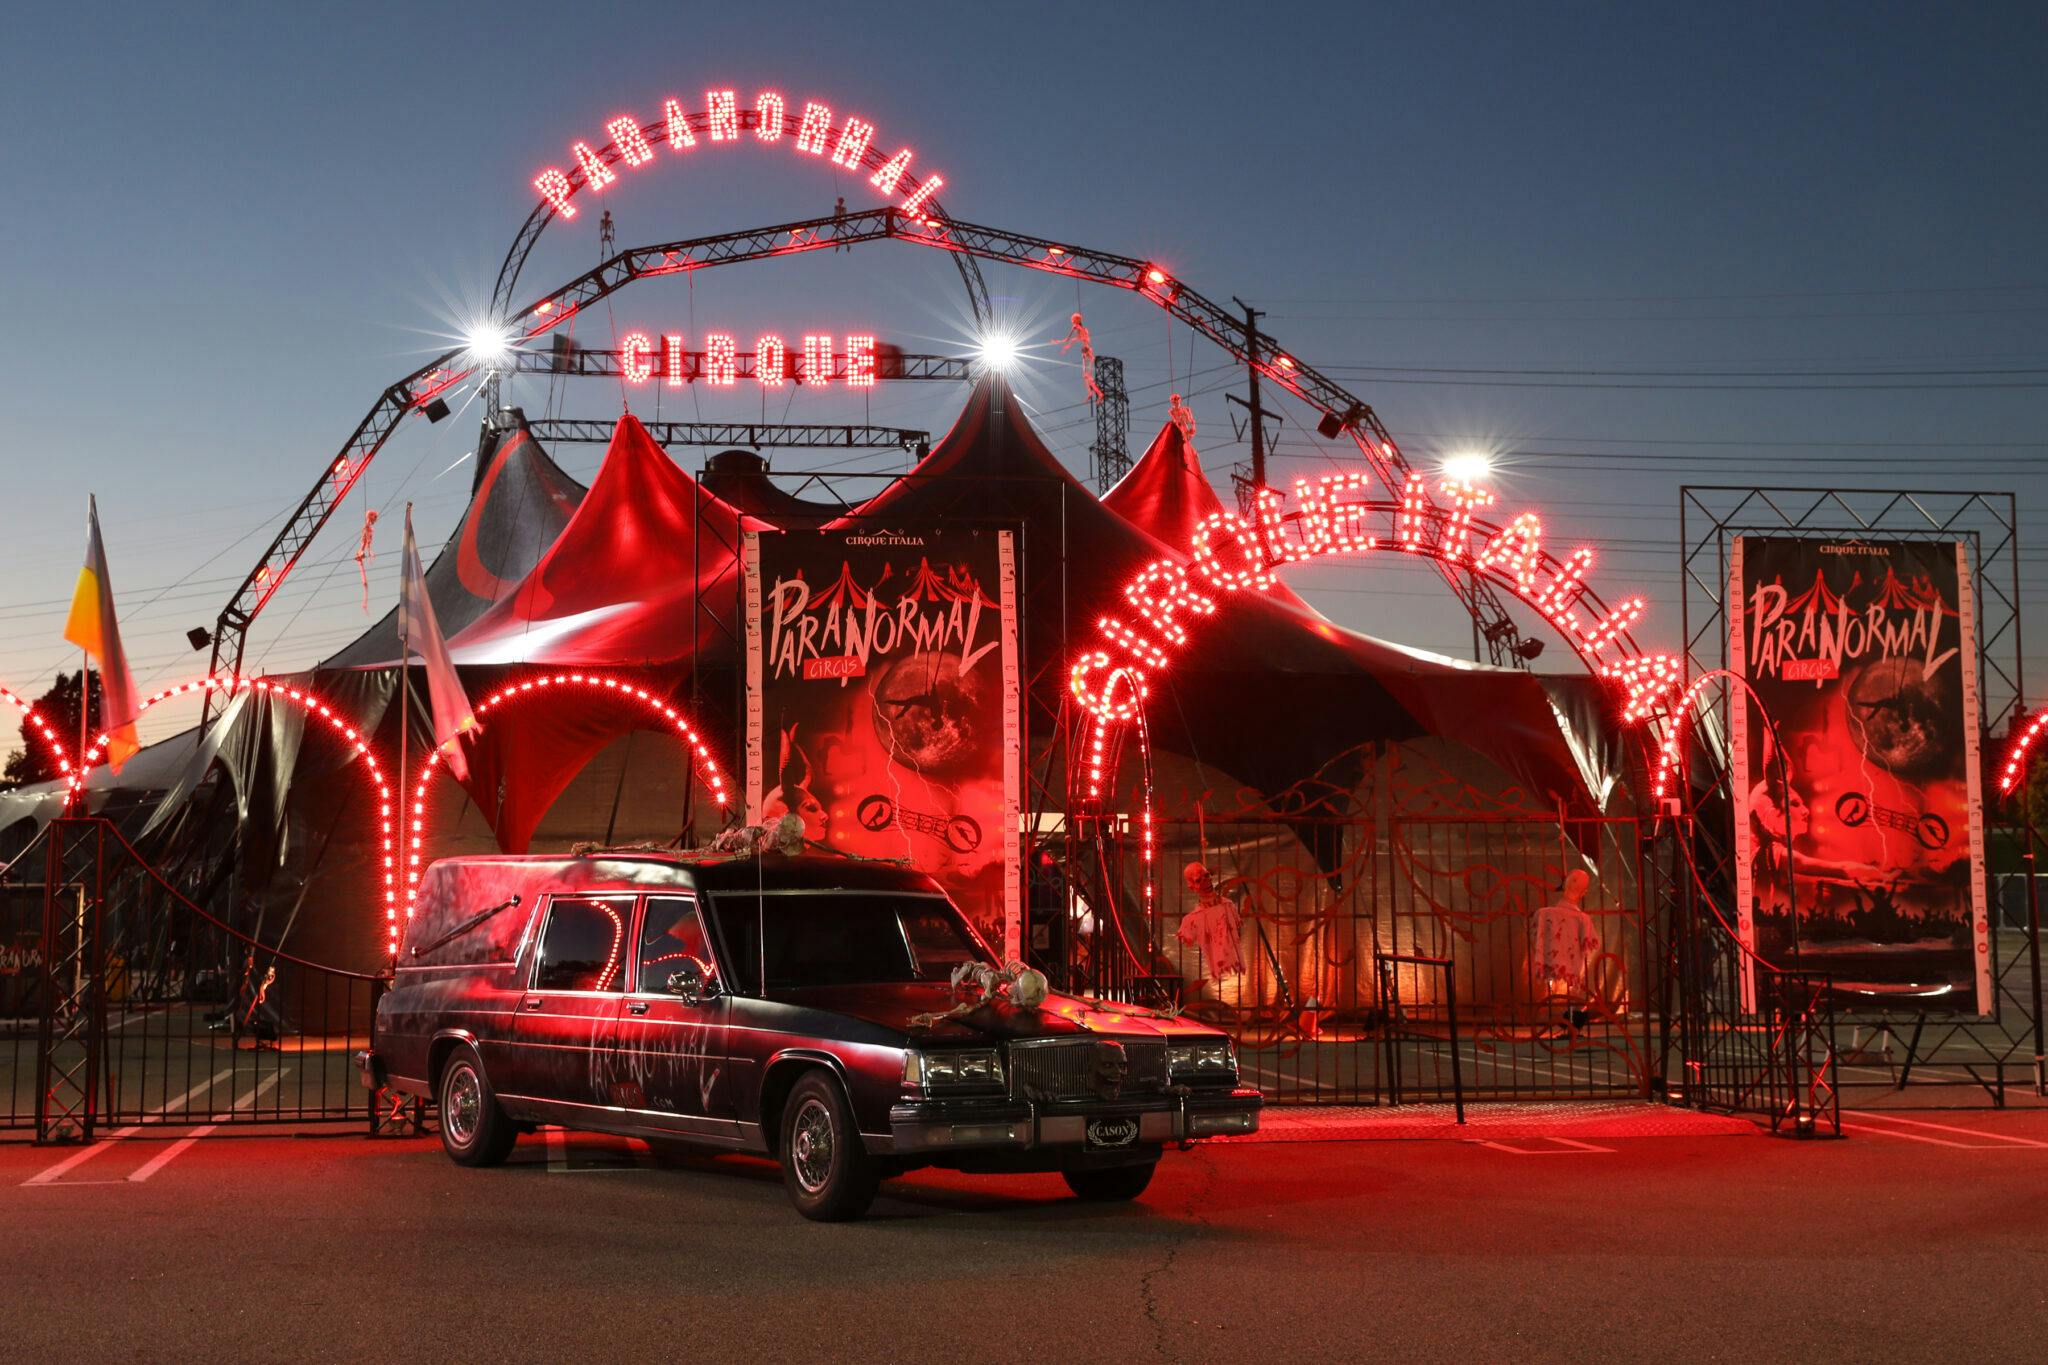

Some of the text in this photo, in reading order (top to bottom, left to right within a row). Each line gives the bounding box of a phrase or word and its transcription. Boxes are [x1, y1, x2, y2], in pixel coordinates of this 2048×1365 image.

[534, 90, 943, 224] PARANORMAL
[623, 332, 875, 386] CIRQUE
[845, 536, 924, 546] CIRQUE ITALIA
[1820, 545, 1890, 556] CIRQUE ITALIA
[768, 575, 999, 688] PARANORMAL
[1071, 473, 1679, 723] CIRQUE ITALIA
[1749, 579, 1959, 689] PARANORMAL
[810, 659, 858, 678] CIRCUS
[1005, 664, 1017, 756] CABARET
[1787, 663, 1831, 679] CIRCUS
[749, 692, 760, 787] CABARET
[1007, 797, 1019, 918] ACROBATIC
[1096, 1125, 1129, 1137] CASON
